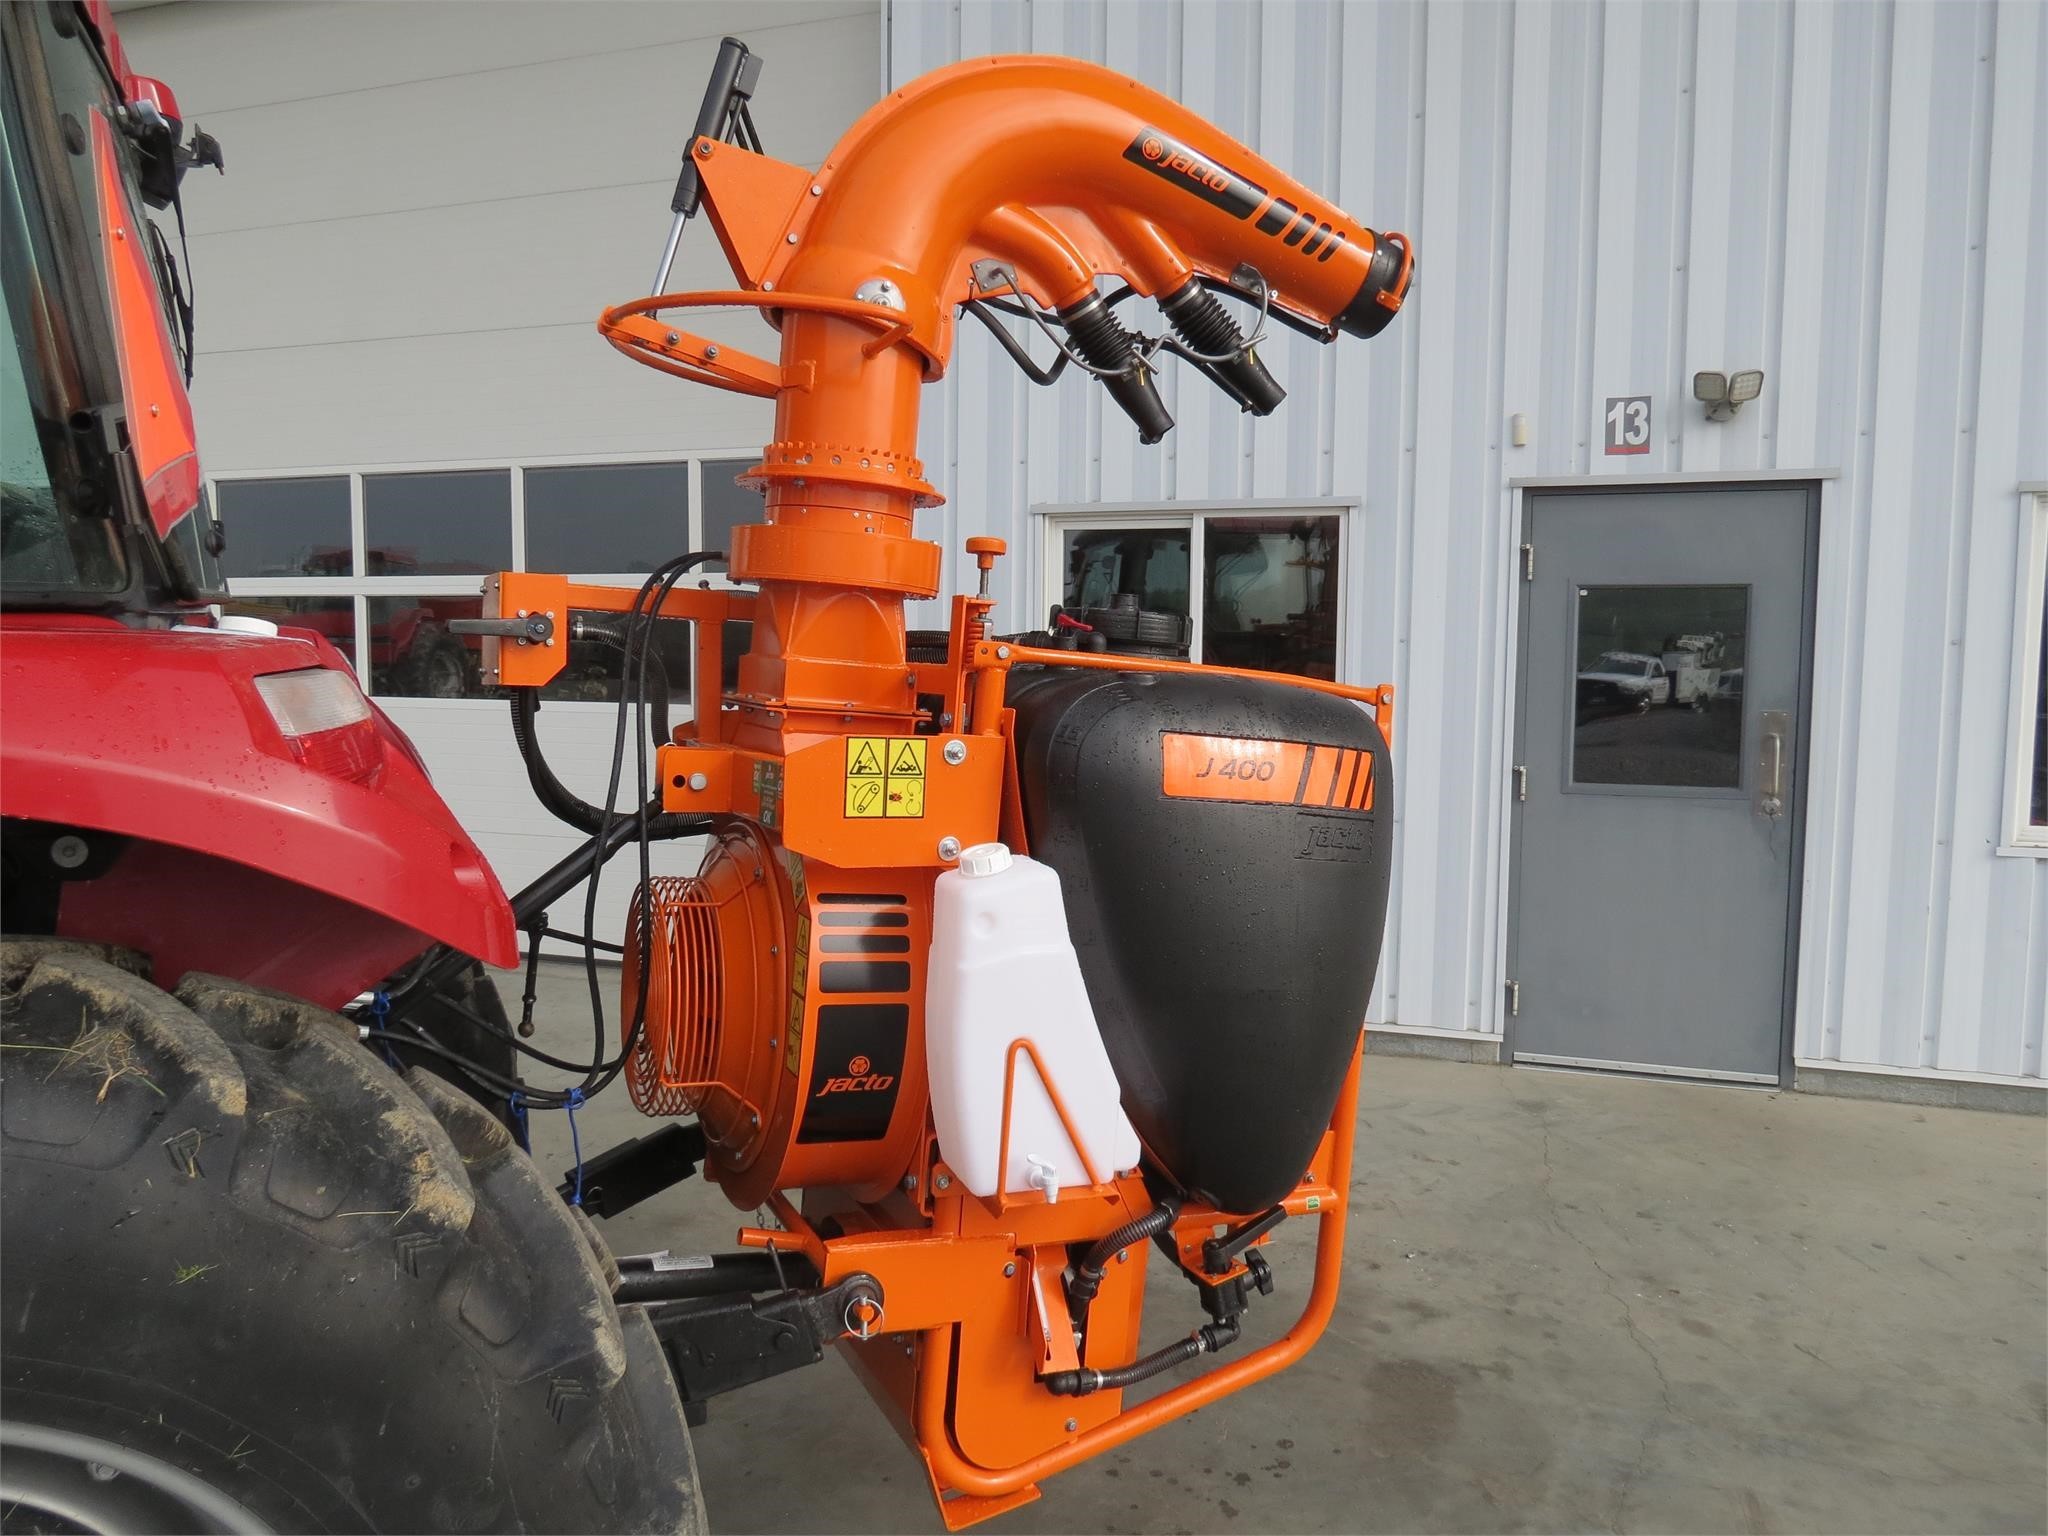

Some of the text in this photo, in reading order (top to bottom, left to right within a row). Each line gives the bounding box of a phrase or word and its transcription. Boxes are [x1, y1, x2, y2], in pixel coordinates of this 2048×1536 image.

[1157, 148, 1231, 193] jacto
[1607, 401, 1649, 446] 13
[1196, 758, 1276, 782] J 400
[815, 1073, 894, 1097] jacto
